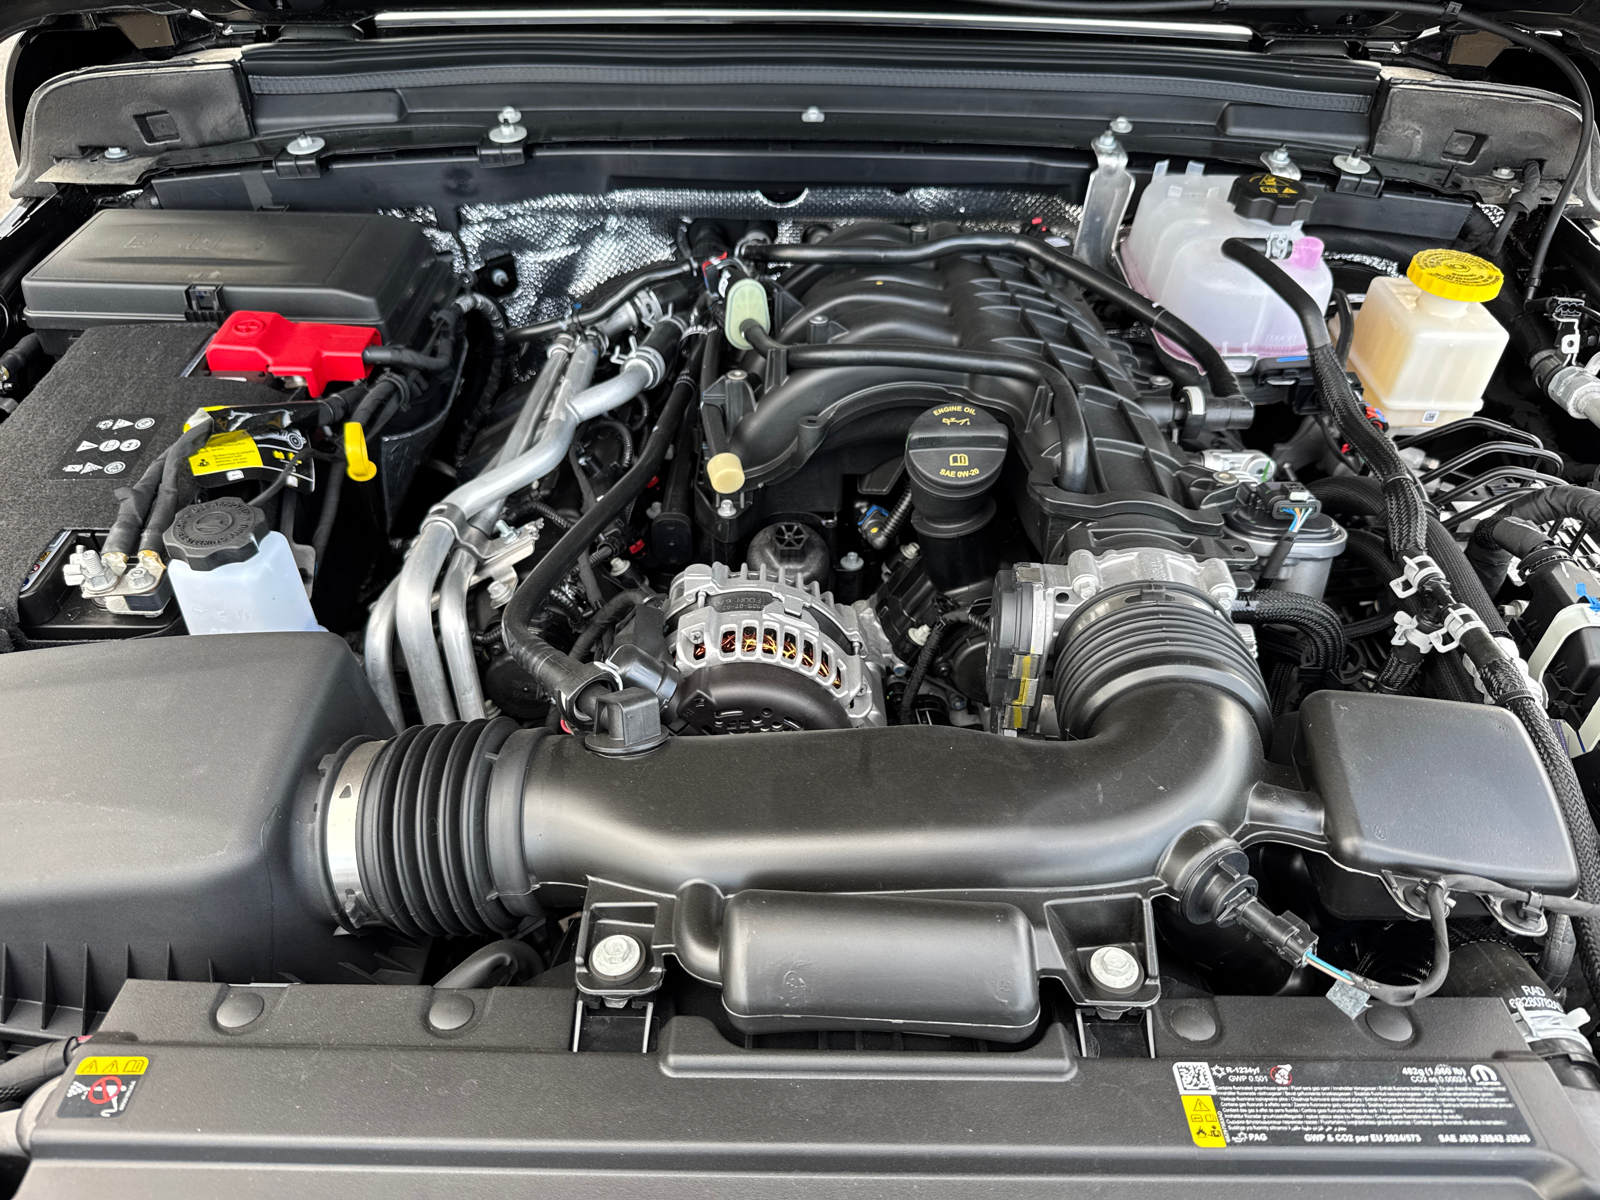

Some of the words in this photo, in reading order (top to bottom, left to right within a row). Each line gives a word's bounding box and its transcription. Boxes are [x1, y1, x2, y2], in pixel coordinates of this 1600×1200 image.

[933, 405, 962, 416] ENGINE
[963, 406, 976, 415] OIL
[940, 468, 956, 477] SAE
[957, 468, 980, 478] 0W-20
[1520, 985, 1546, 997] RAD
[1248, 1075, 1269, 1083] 0.501
[1410, 1075, 1428, 1083] CO2
[1248, 1133, 1268, 1142] PAG
[1304, 1134, 1326, 1142] GWP
[1335, 1134, 1354, 1142] CO2
[1370, 1134, 1383, 1142] EU
